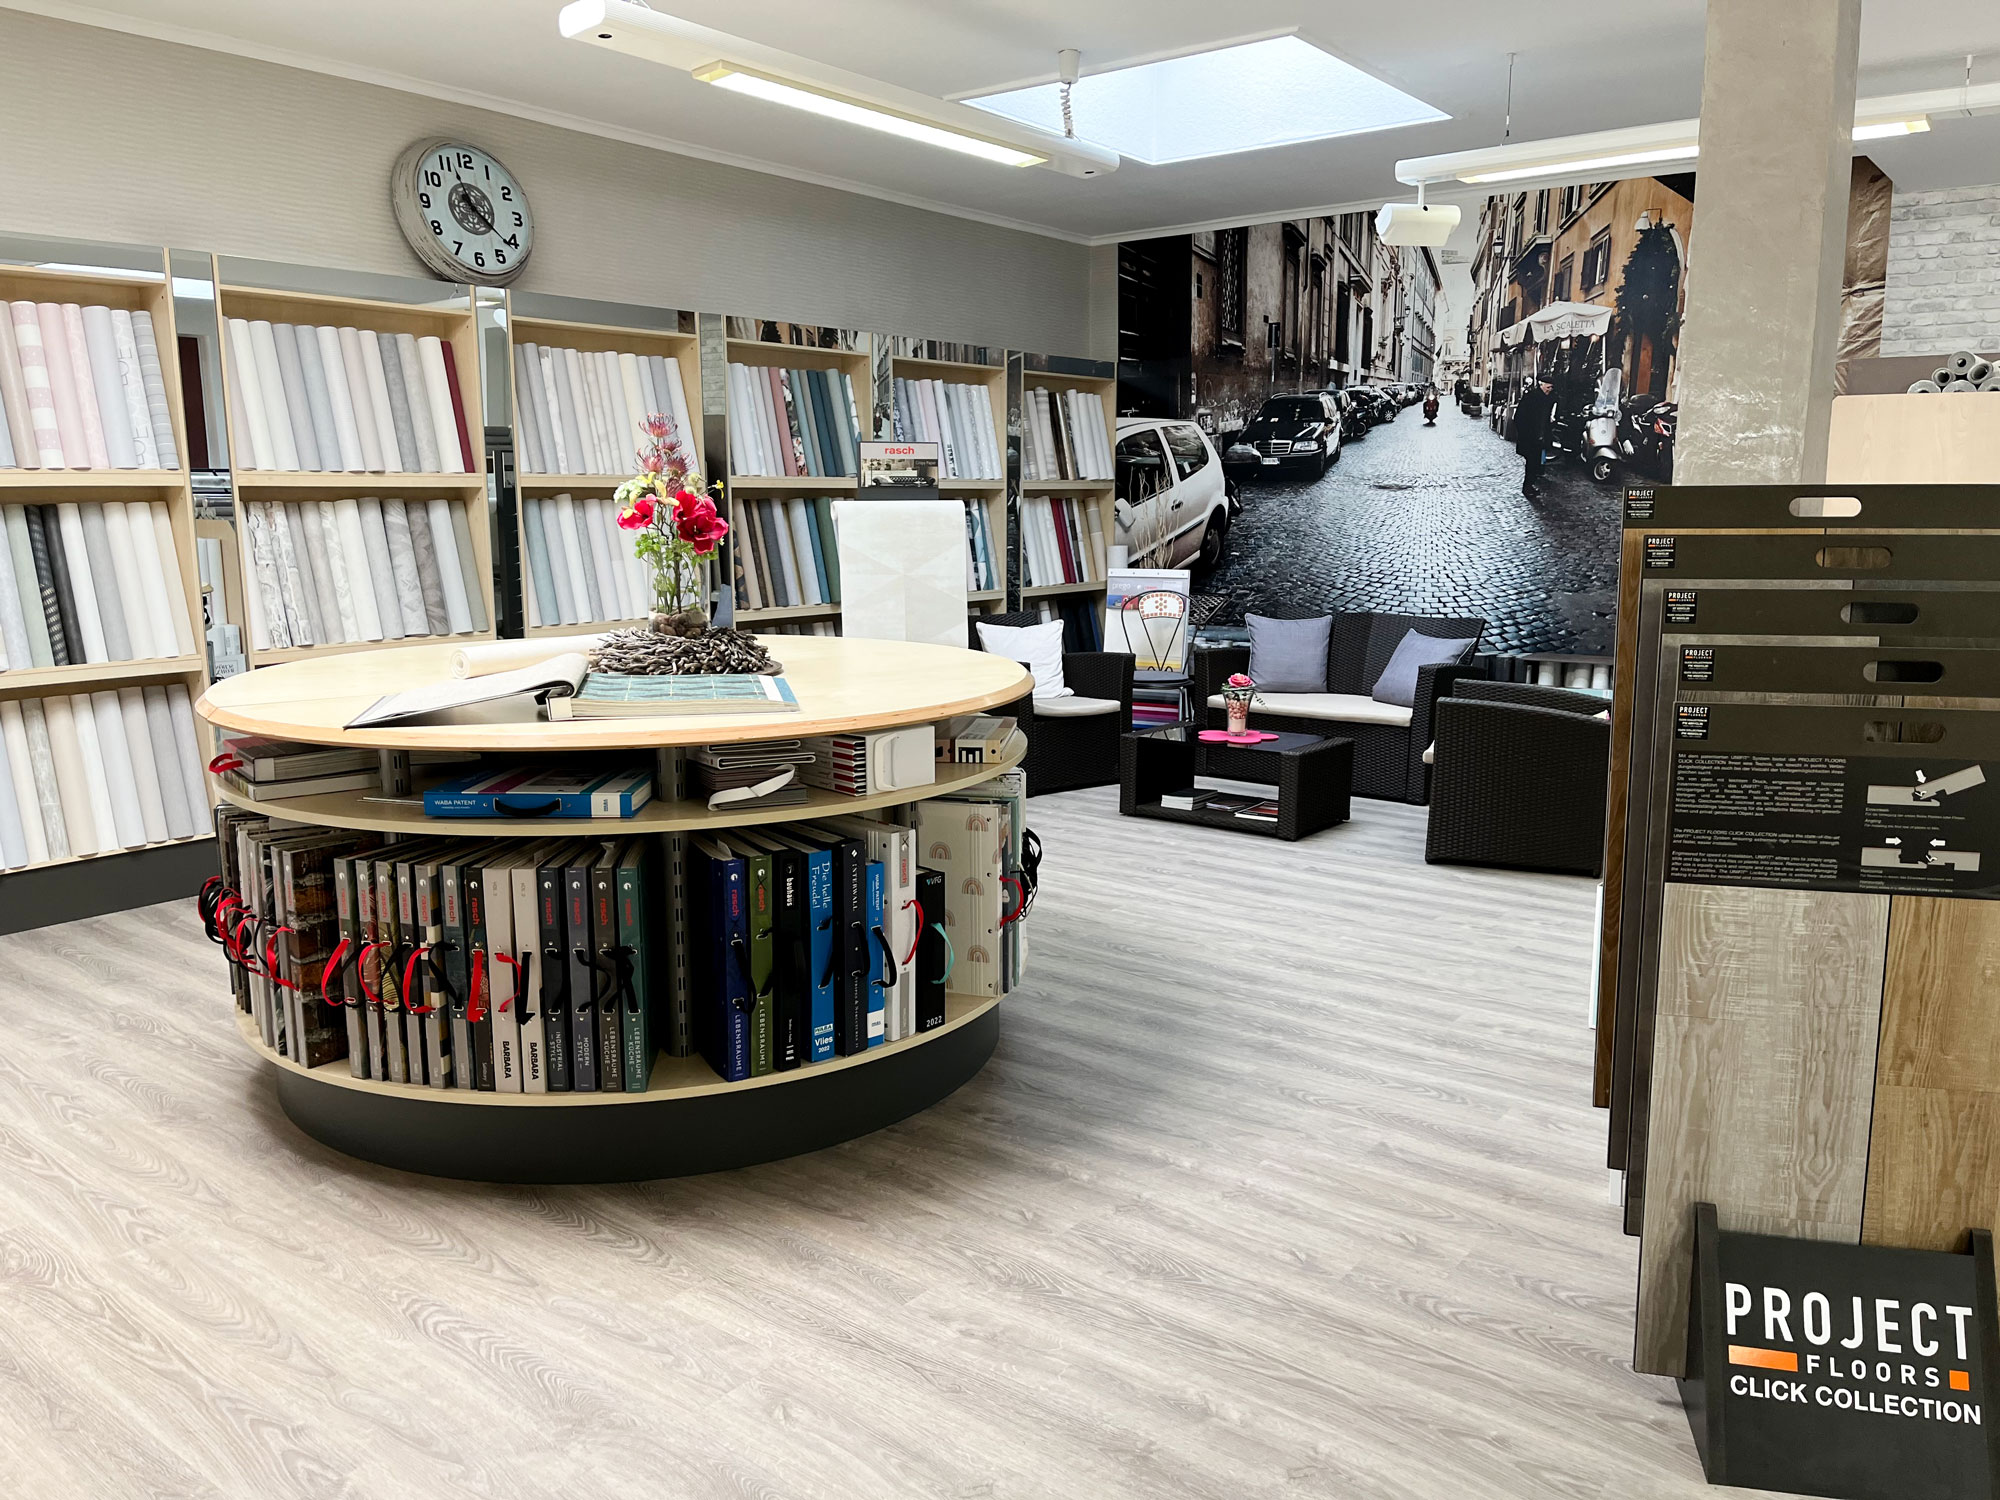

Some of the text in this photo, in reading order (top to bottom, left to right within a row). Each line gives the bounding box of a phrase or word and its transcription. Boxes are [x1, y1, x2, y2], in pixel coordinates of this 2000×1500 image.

[439, 155, 451, 172] 11
[457, 153, 474, 170] 12
[424, 170, 441, 187] 10
[485, 165, 490, 180] 1
[420, 193, 431, 208] 9
[501, 186, 512, 201] 2
[512, 211, 523, 227] 3
[431, 220, 443, 235] 8
[453, 241, 463, 255] 7
[507, 234, 519, 249] 4
[474, 252, 485, 267] 6
[495, 249, 506, 264] 5
[1543, 325, 1554, 333] LA
[1556, 320, 1595, 331] SCALETTA
[885, 446, 914, 454] rasch
[1112, 583, 1130, 591] prego
[822, 861, 831, 909] Die helle
[732, 889, 740, 916] rasch
[545, 897, 553, 925] rasch
[600, 898, 608, 925] rasch
[926, 1016, 943, 1027] 2022
[815, 1036, 833, 1046] Vlies
[503, 1041, 511, 1078] BARBARA
[530, 1042, 539, 1080] BARBARA
[1725, 1282, 1973, 1360] PROJECT
[1806, 1354, 1940, 1388] FLOORS
[1730, 1374, 1982, 1425] CLICK COLLECTION
